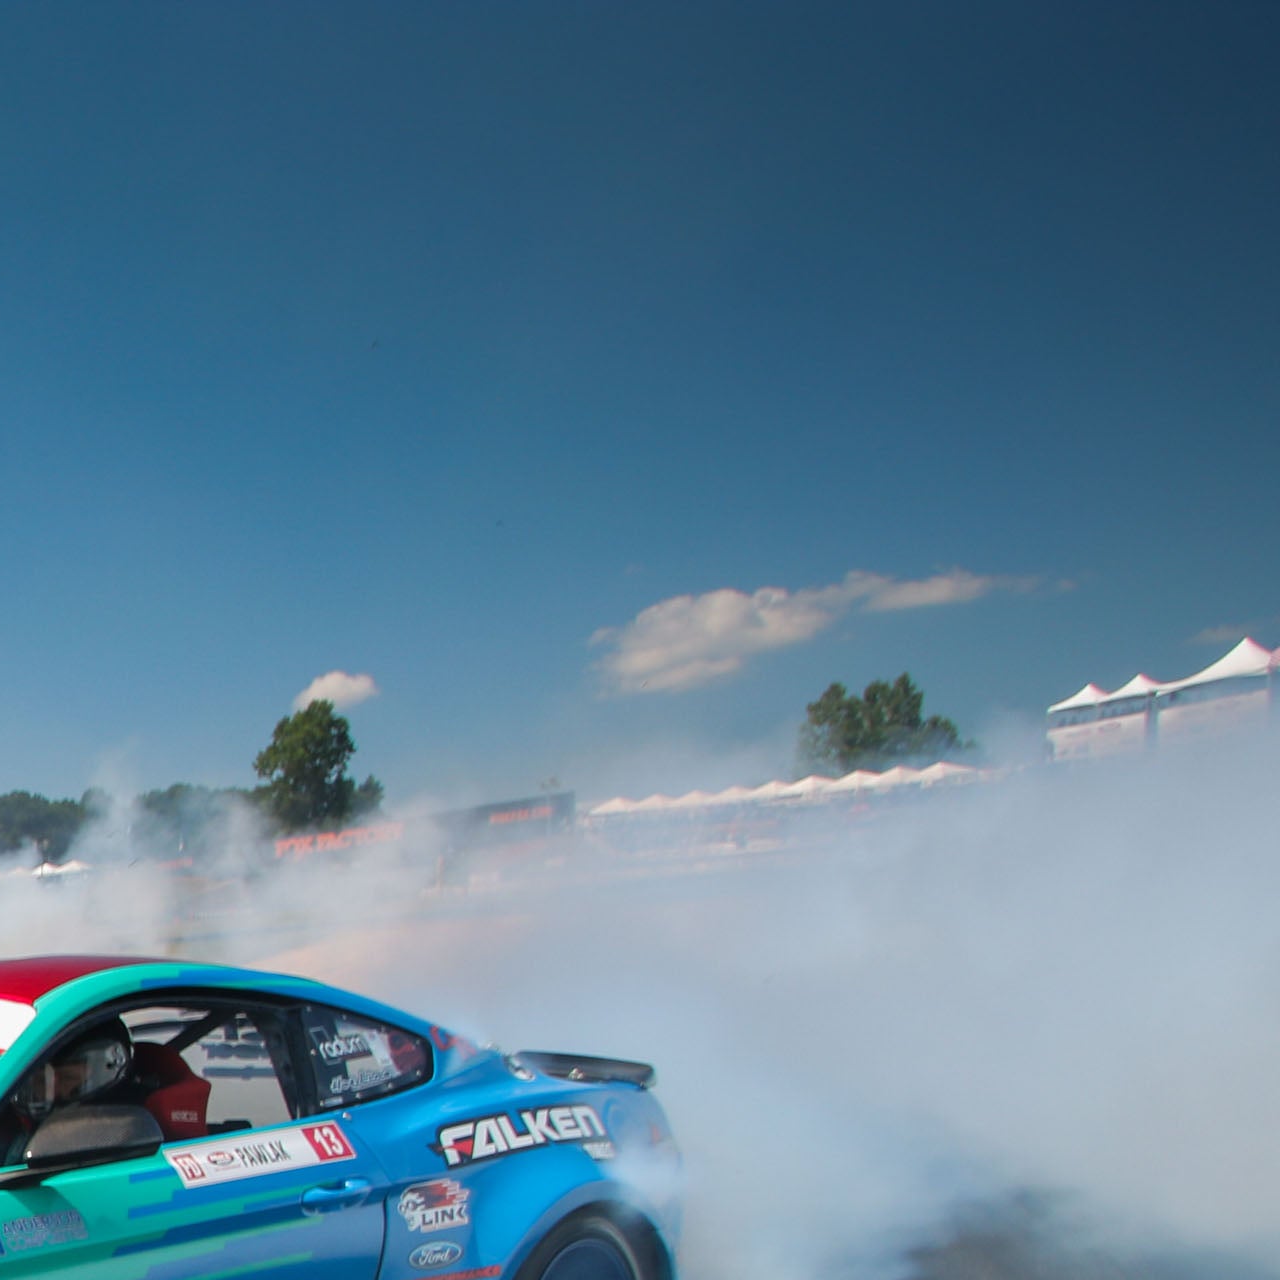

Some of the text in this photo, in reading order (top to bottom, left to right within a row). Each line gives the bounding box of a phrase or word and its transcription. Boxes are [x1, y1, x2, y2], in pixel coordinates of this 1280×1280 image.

[234, 1140, 291, 1168] PAWLAK
[312, 1125, 345, 1156] 13
[439, 1105, 608, 1166] FALKEN
